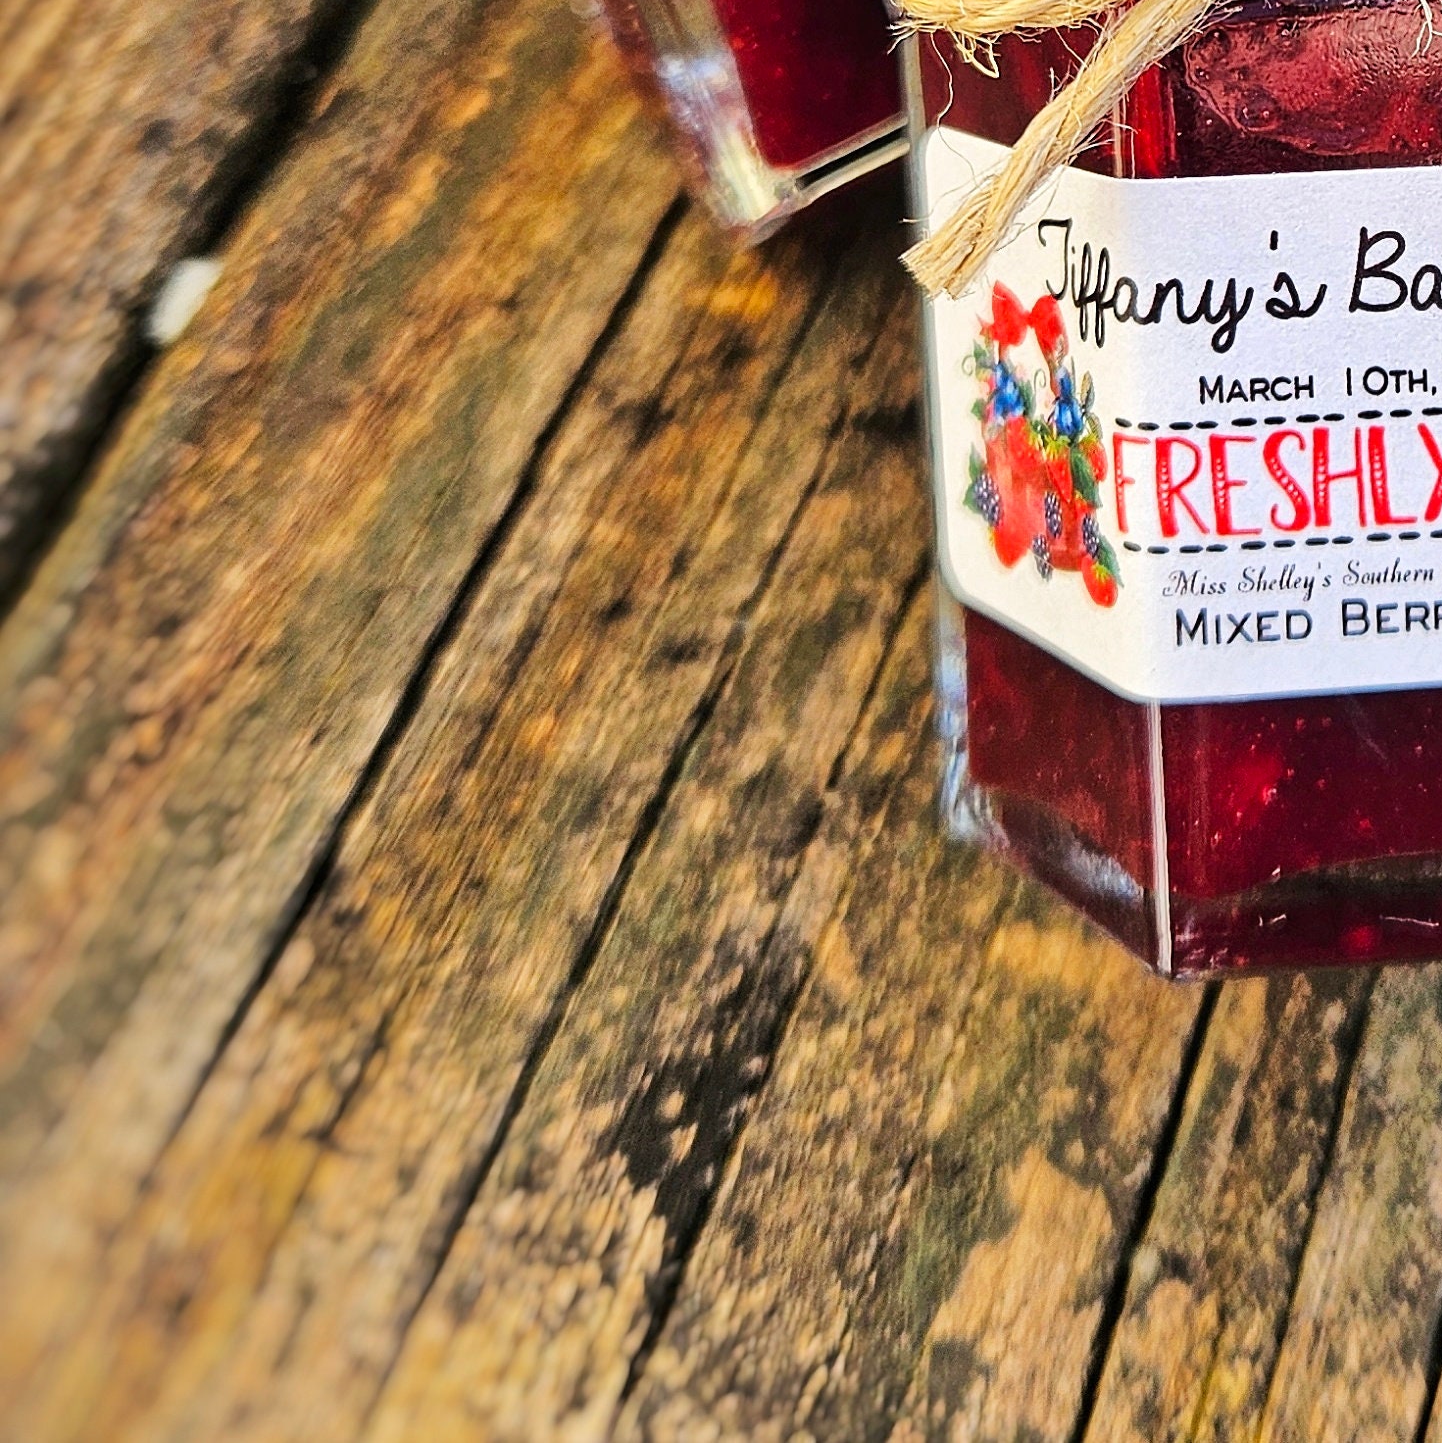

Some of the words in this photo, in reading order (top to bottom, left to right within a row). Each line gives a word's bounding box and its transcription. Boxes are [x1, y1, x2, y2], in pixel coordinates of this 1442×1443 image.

[1037, 216, 1329, 355] Tiffany's
[1198, 374, 1315, 405] MARCH
[1161, 568, 1228, 598] Miss
[1237, 561, 1333, 602] Shelley's
[1342, 556, 1434, 586] Southern
[1175, 607, 1313, 647] MIXED
